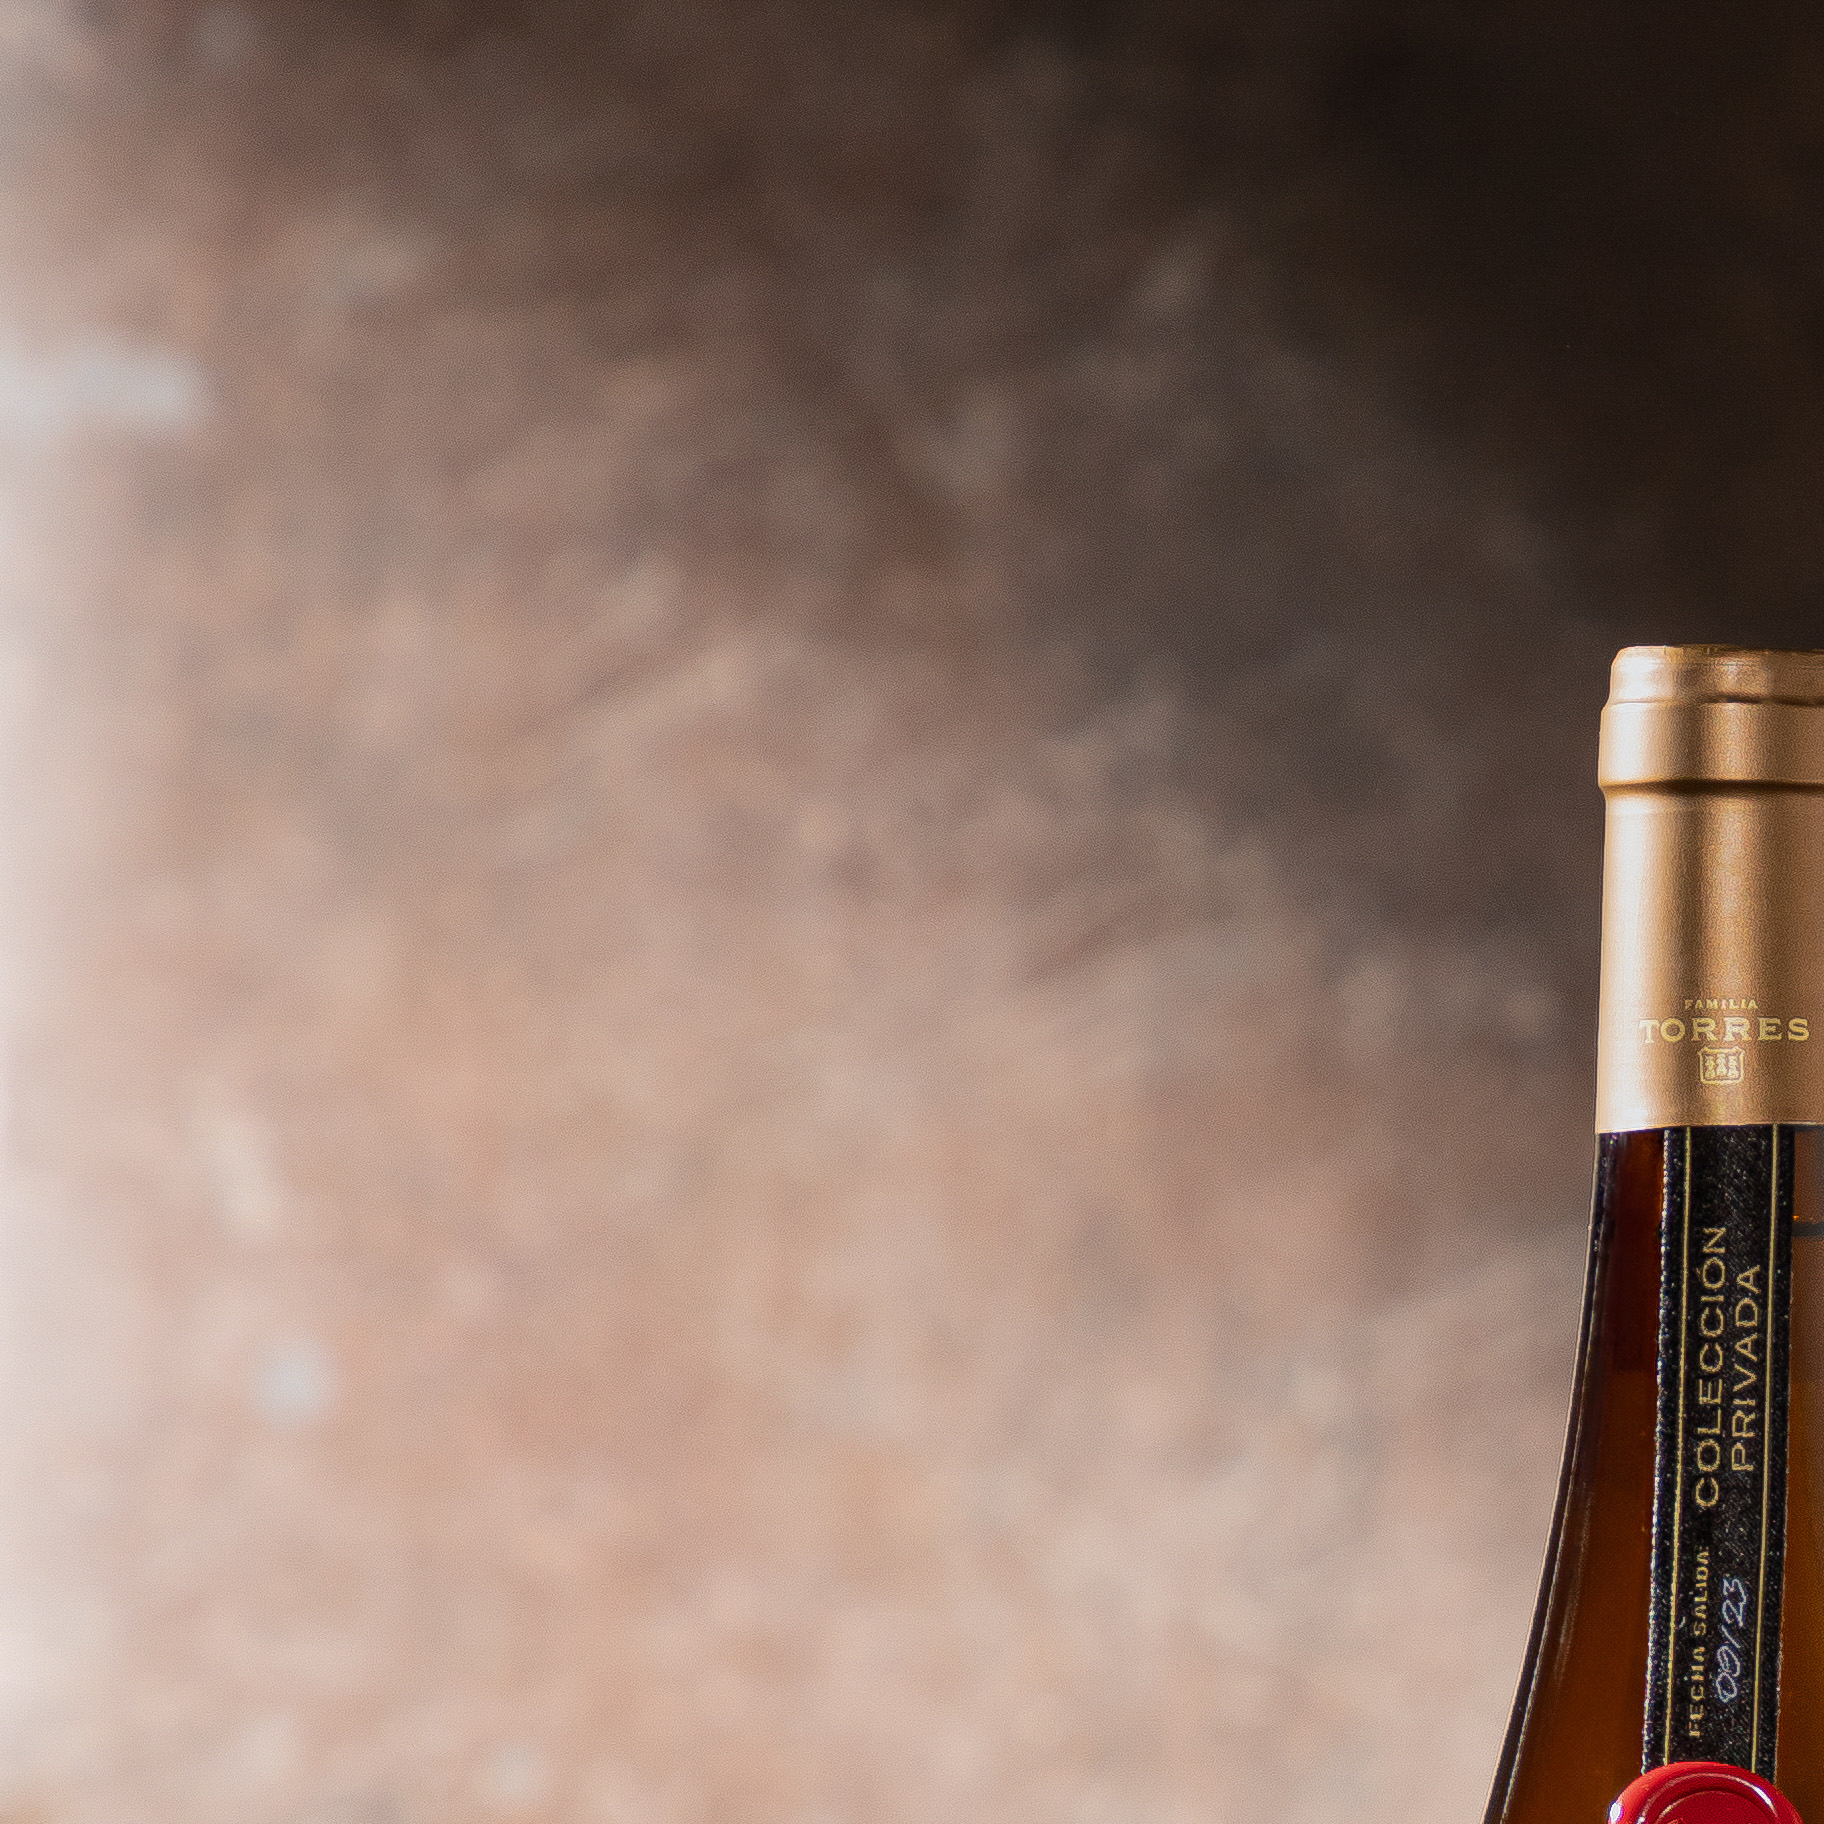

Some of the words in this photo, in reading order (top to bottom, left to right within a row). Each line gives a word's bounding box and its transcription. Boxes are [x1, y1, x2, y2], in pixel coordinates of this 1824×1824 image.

[1639, 1016, 1810, 1044] TORRES
[1684, 998, 1759, 1010] FAMILIA
[1696, 1227, 1728, 1507] COLECCIÓN
[1732, 1265, 1761, 1470] PRIVADA
[1688, 1647, 1706, 1738] FECHA
